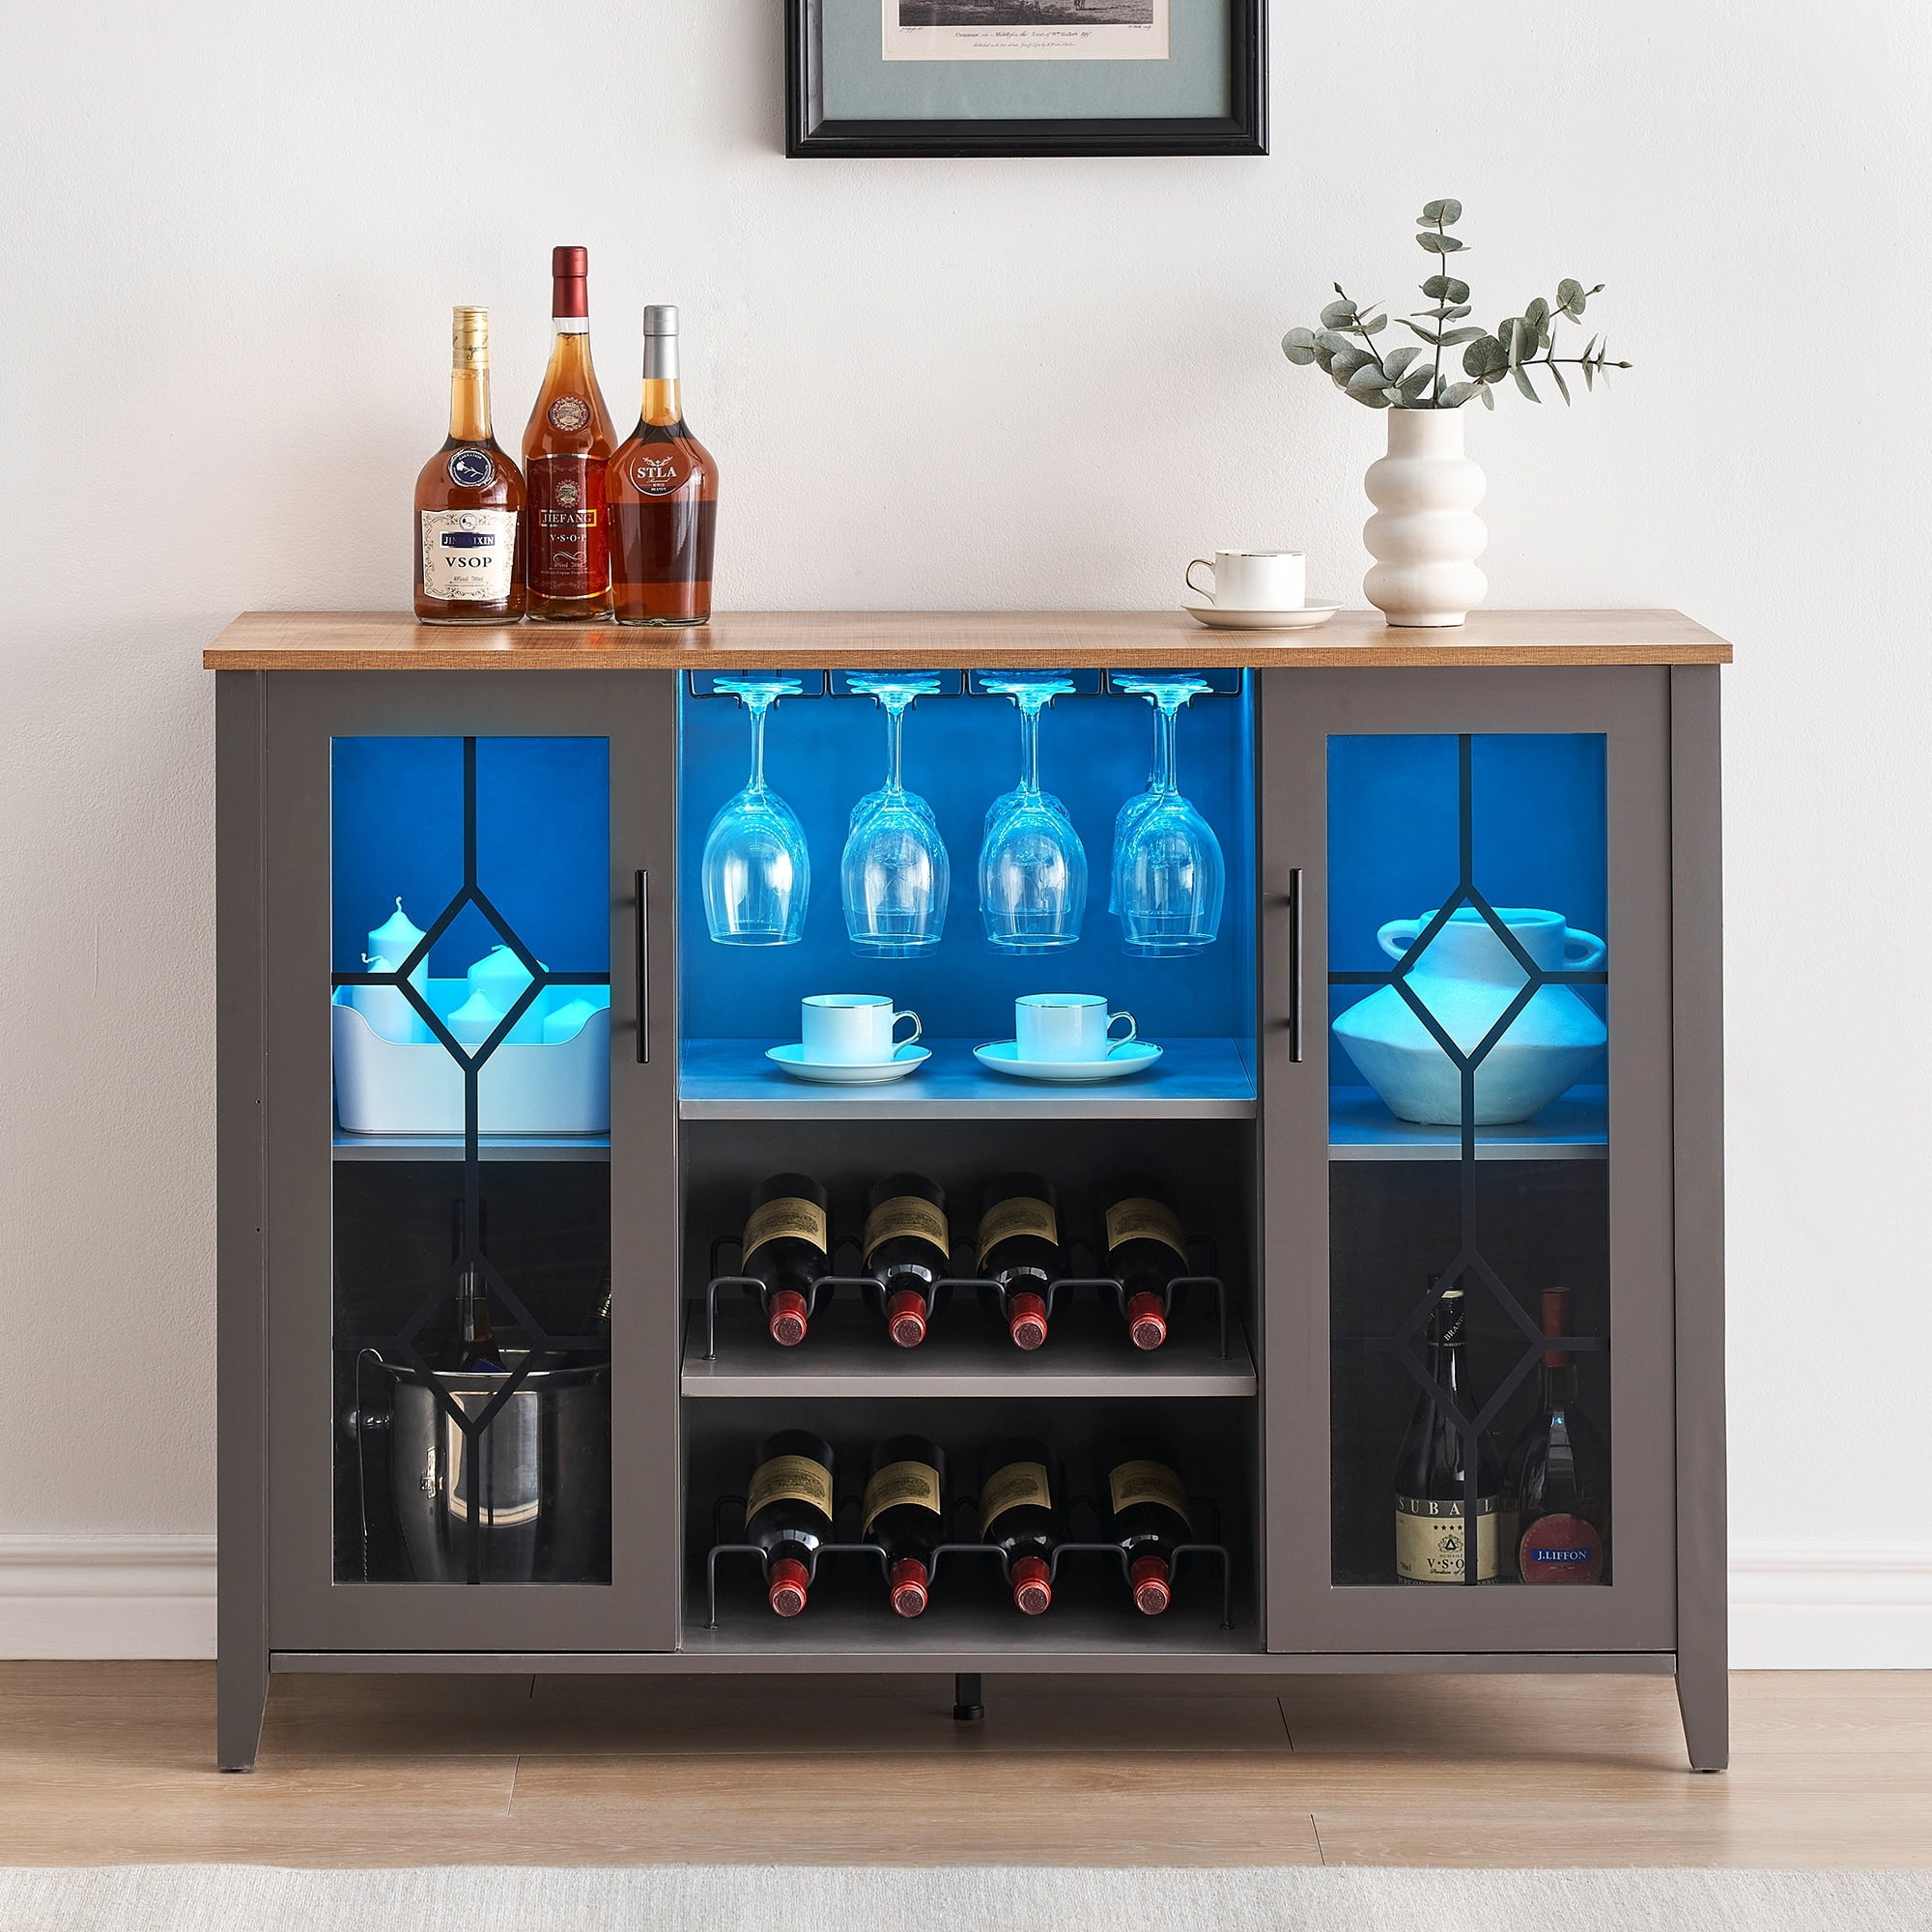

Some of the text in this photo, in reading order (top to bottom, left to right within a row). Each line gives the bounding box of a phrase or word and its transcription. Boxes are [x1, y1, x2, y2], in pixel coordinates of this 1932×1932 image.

[637, 466, 678, 479] STLA
[542, 513, 592, 524] JIEFANG
[445, 556, 493, 568] VSOP
[1537, 1549, 1587, 1561] J.LIFFON
